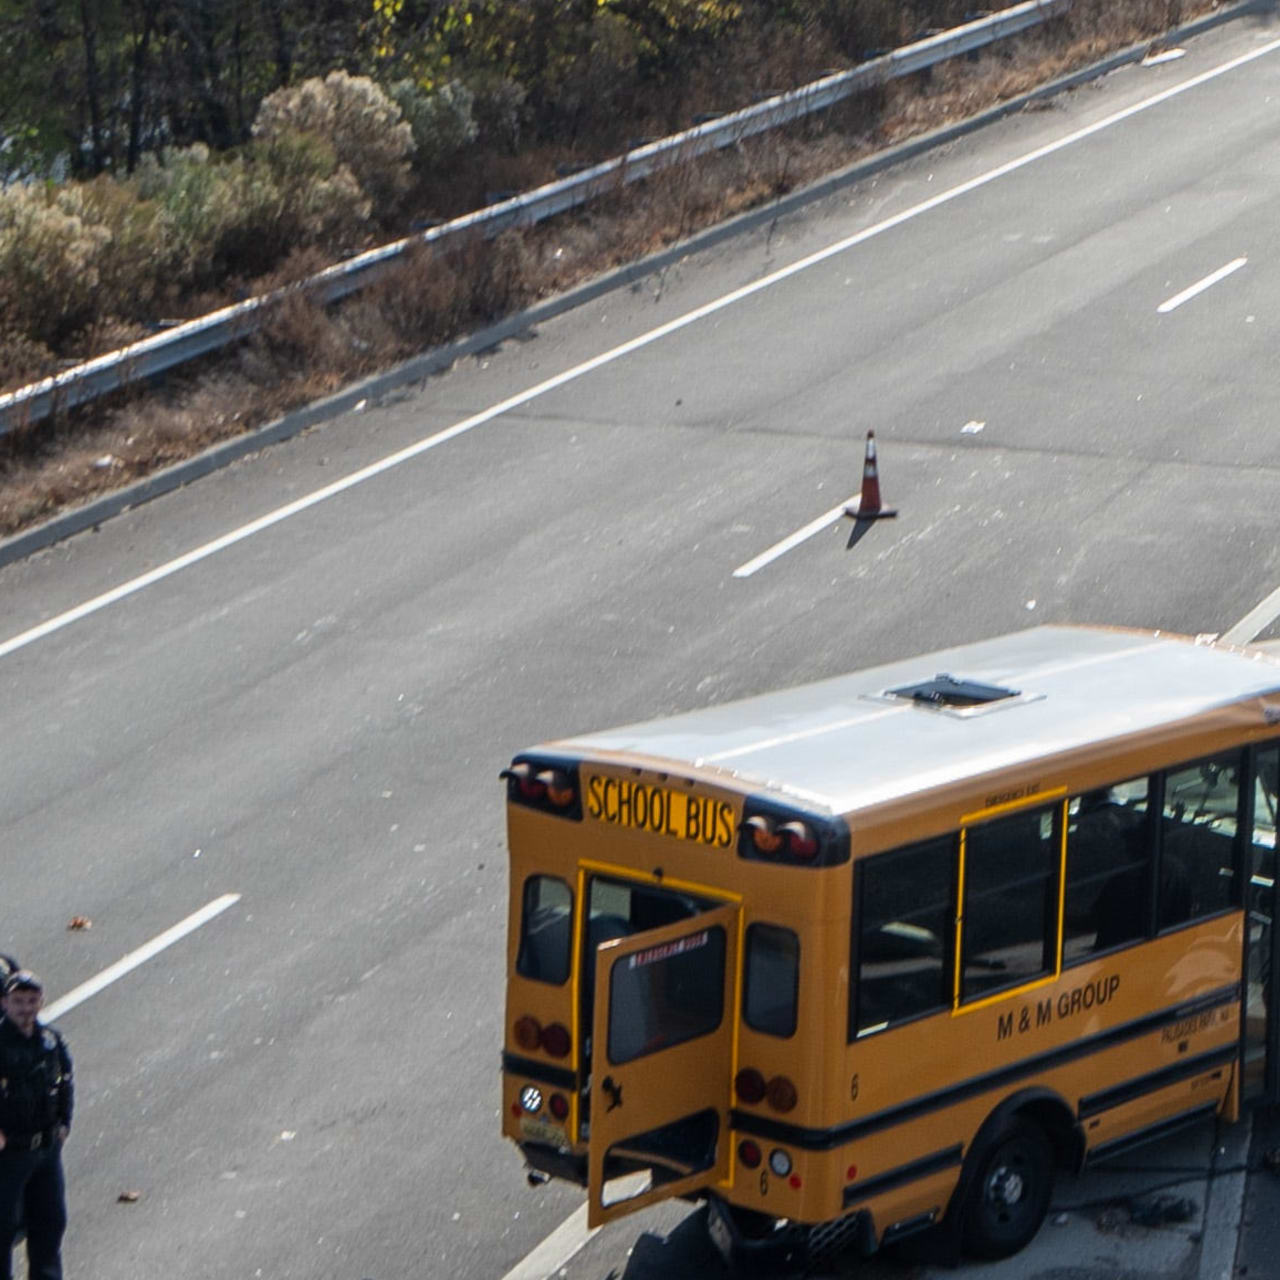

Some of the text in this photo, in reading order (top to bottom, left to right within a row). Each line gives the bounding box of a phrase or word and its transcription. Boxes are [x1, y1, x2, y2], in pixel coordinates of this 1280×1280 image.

[589, 775, 733, 848] SCHOOL BUS
[997, 974, 1120, 1041] M & M GROUP
[851, 1073, 859, 1102] 6
[760, 1169, 768, 1197] 6
